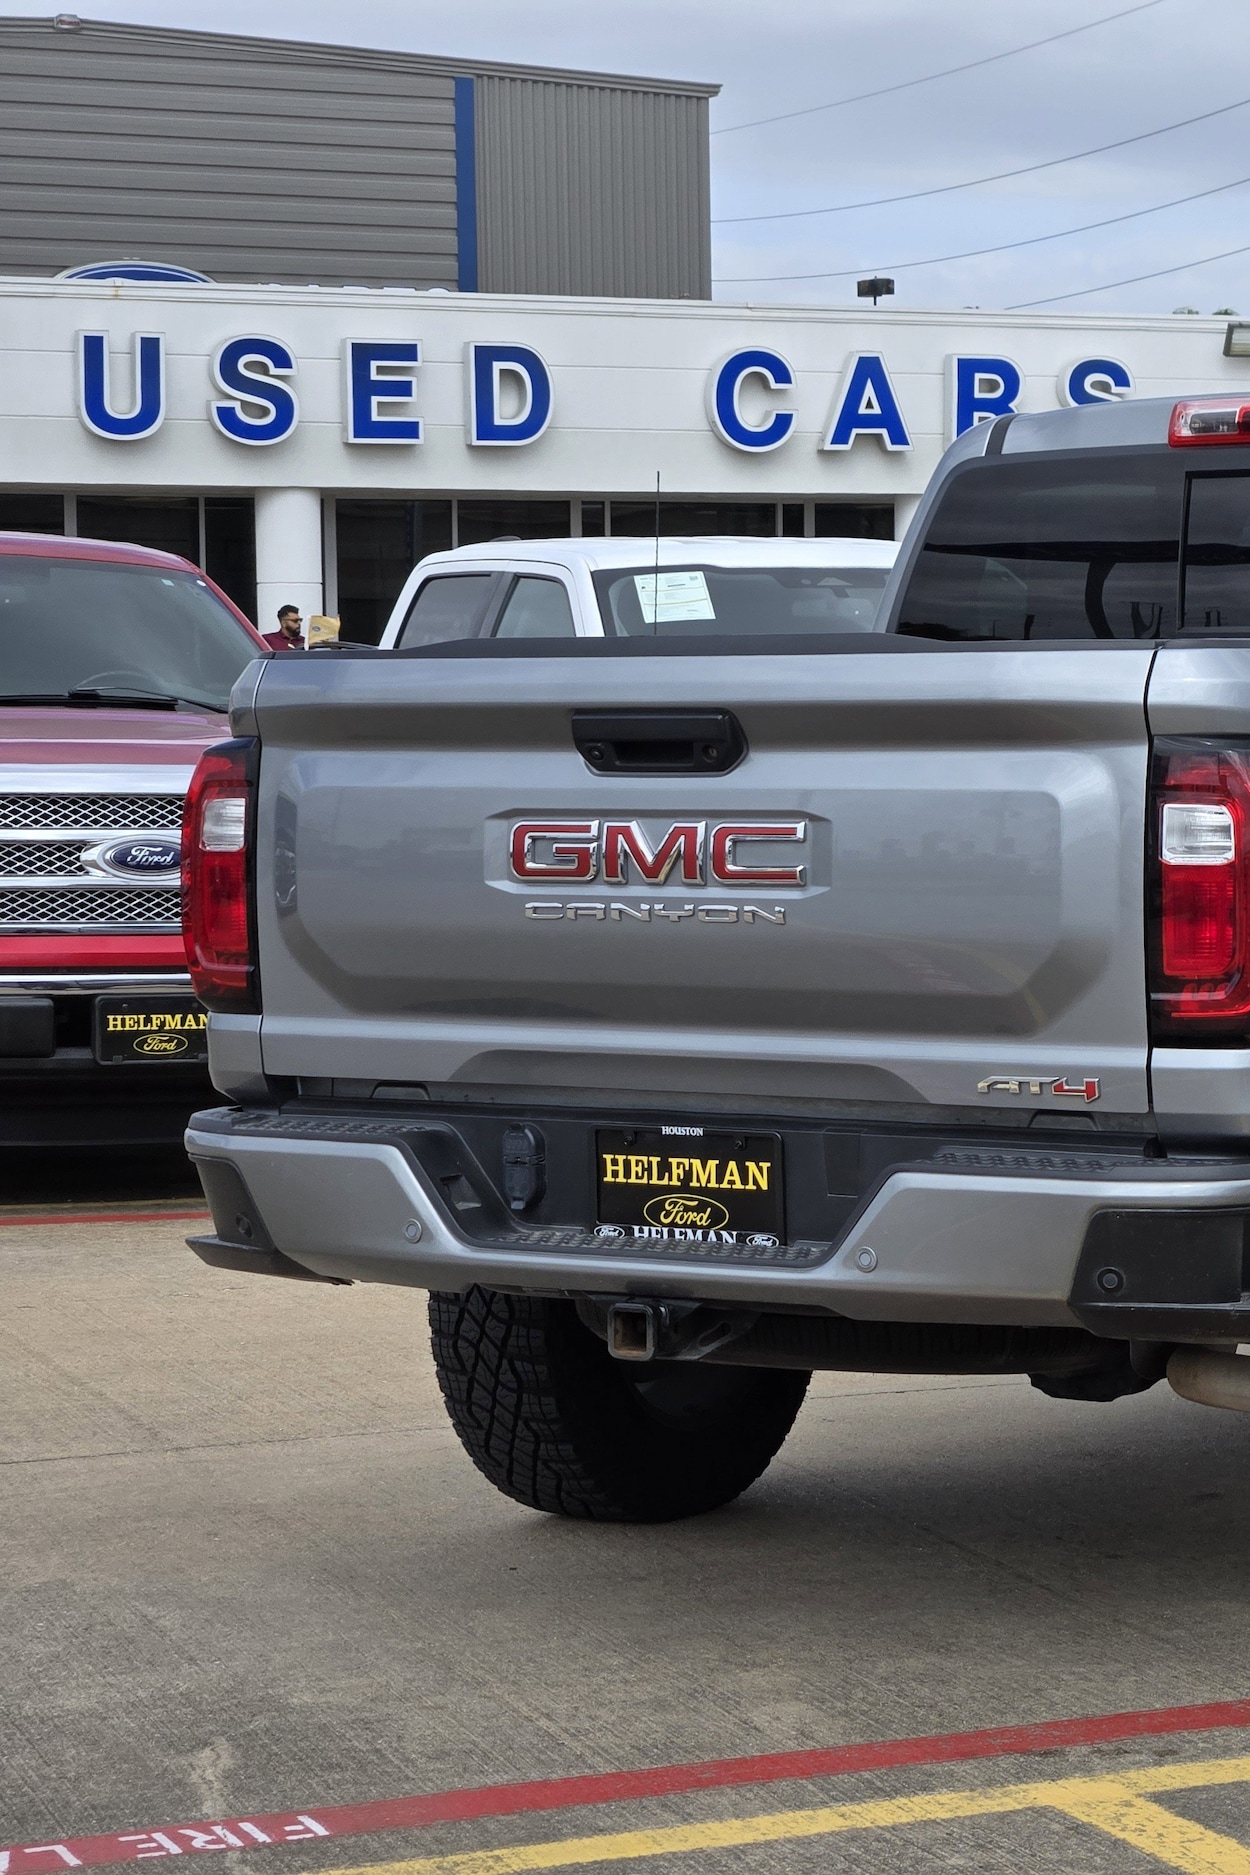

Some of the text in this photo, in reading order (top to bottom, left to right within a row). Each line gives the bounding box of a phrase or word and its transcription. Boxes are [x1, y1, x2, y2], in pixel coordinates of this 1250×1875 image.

[78, 330, 554, 446] USED
[127, 845, 175, 866] Ford
[510, 819, 806, 885] GMC
[525, 902, 786, 925] CANYON
[143, 1036, 178, 1051] Ford
[977, 1075, 1099, 1103] AT4
[661, 1126, 704, 1136] HOUSTON
[602, 1153, 771, 1191] HELFMAN
[660, 1197, 712, 1226] Ford
[0, 1815, 330, 1875] FIRE L
